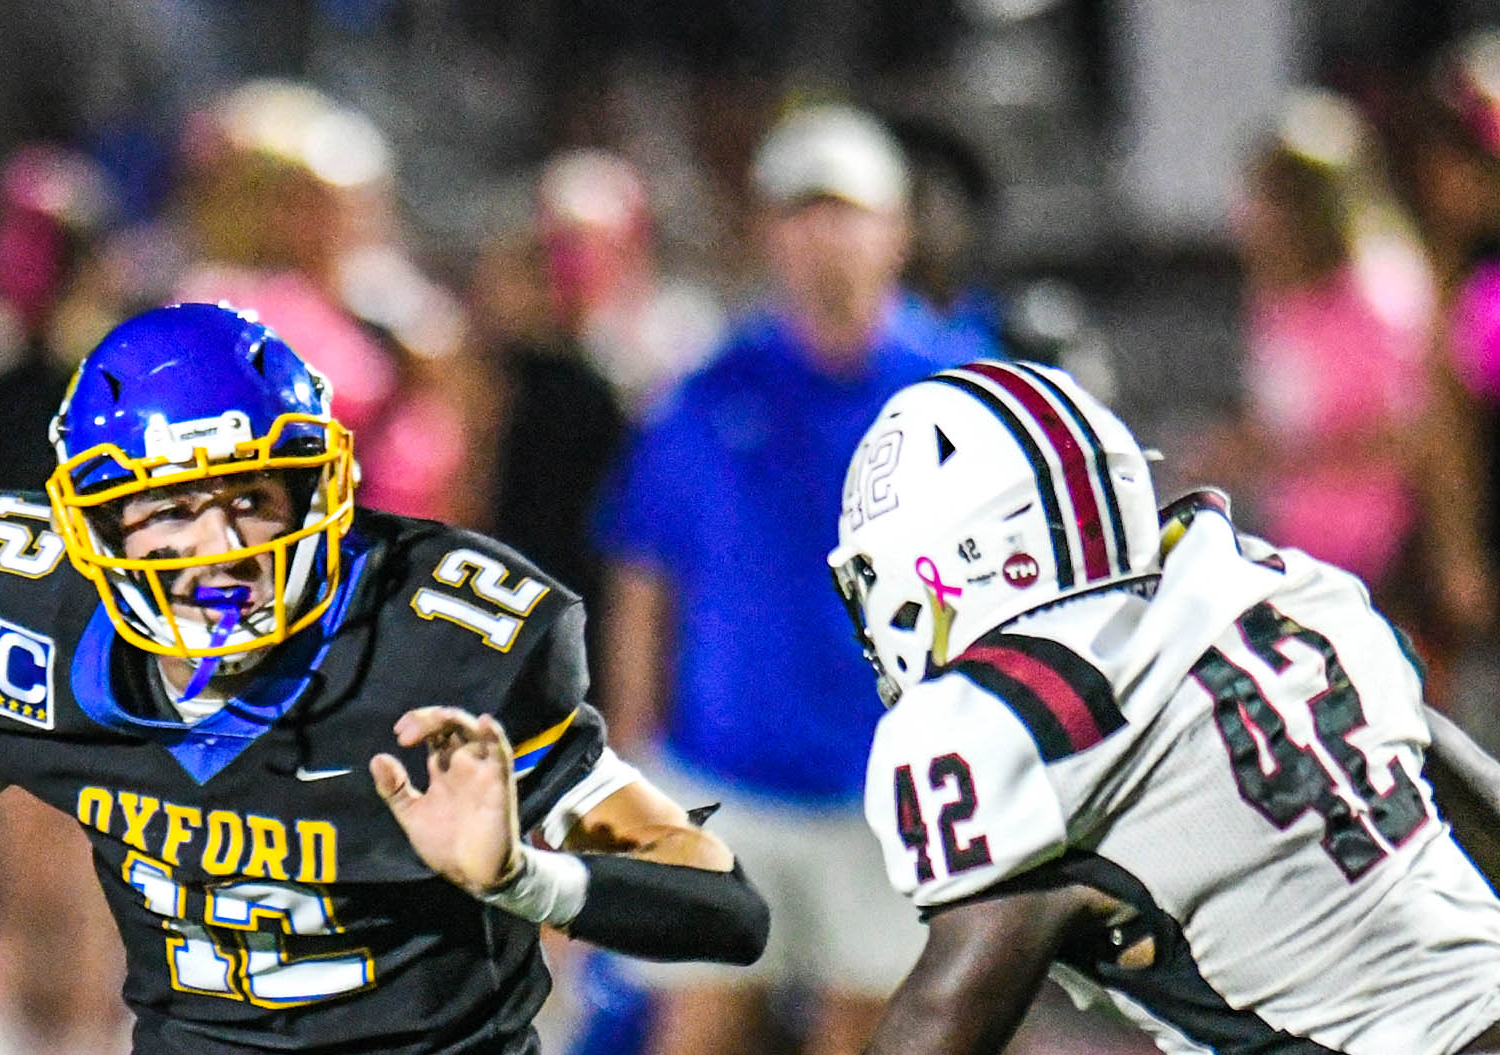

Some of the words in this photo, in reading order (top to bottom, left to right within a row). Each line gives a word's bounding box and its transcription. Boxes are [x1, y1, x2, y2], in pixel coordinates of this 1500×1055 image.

[410, 549, 550, 653] 12
[1189, 600, 1430, 884] 42
[77, 786, 338, 884] OXFORD
[894, 752, 995, 885] 42
[122, 850, 377, 1010] 12
